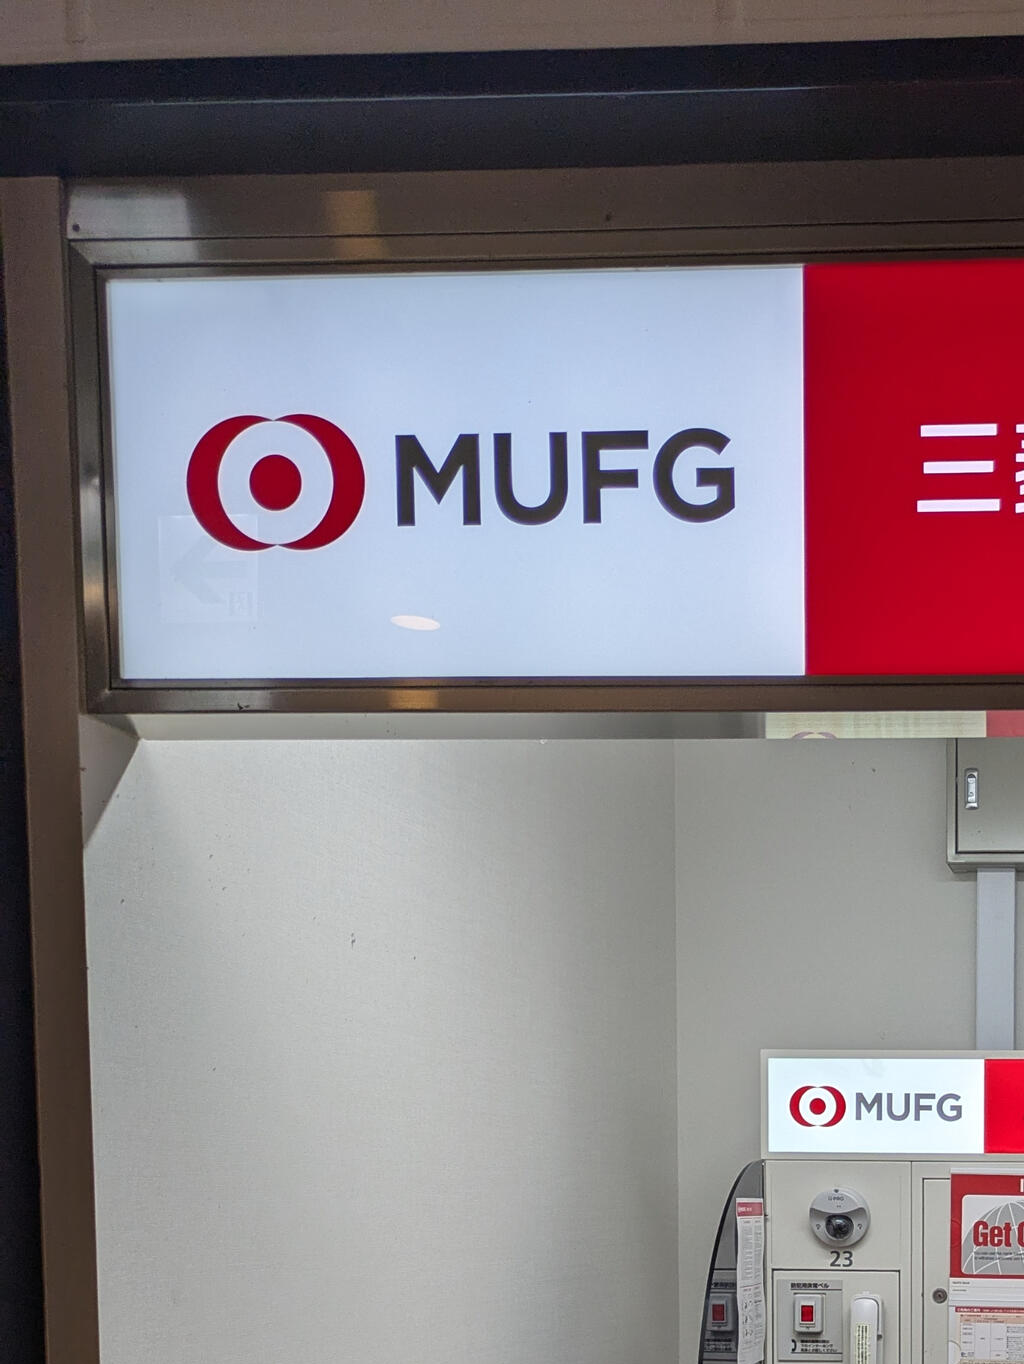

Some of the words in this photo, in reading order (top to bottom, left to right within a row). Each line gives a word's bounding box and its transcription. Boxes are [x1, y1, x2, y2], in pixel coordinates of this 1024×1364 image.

[394, 427, 736, 527] MUFG
[854, 1092, 963, 1122] MUFG
[972, 1221, 1012, 1247] Get
[829, 1250, 854, 1267] 23
